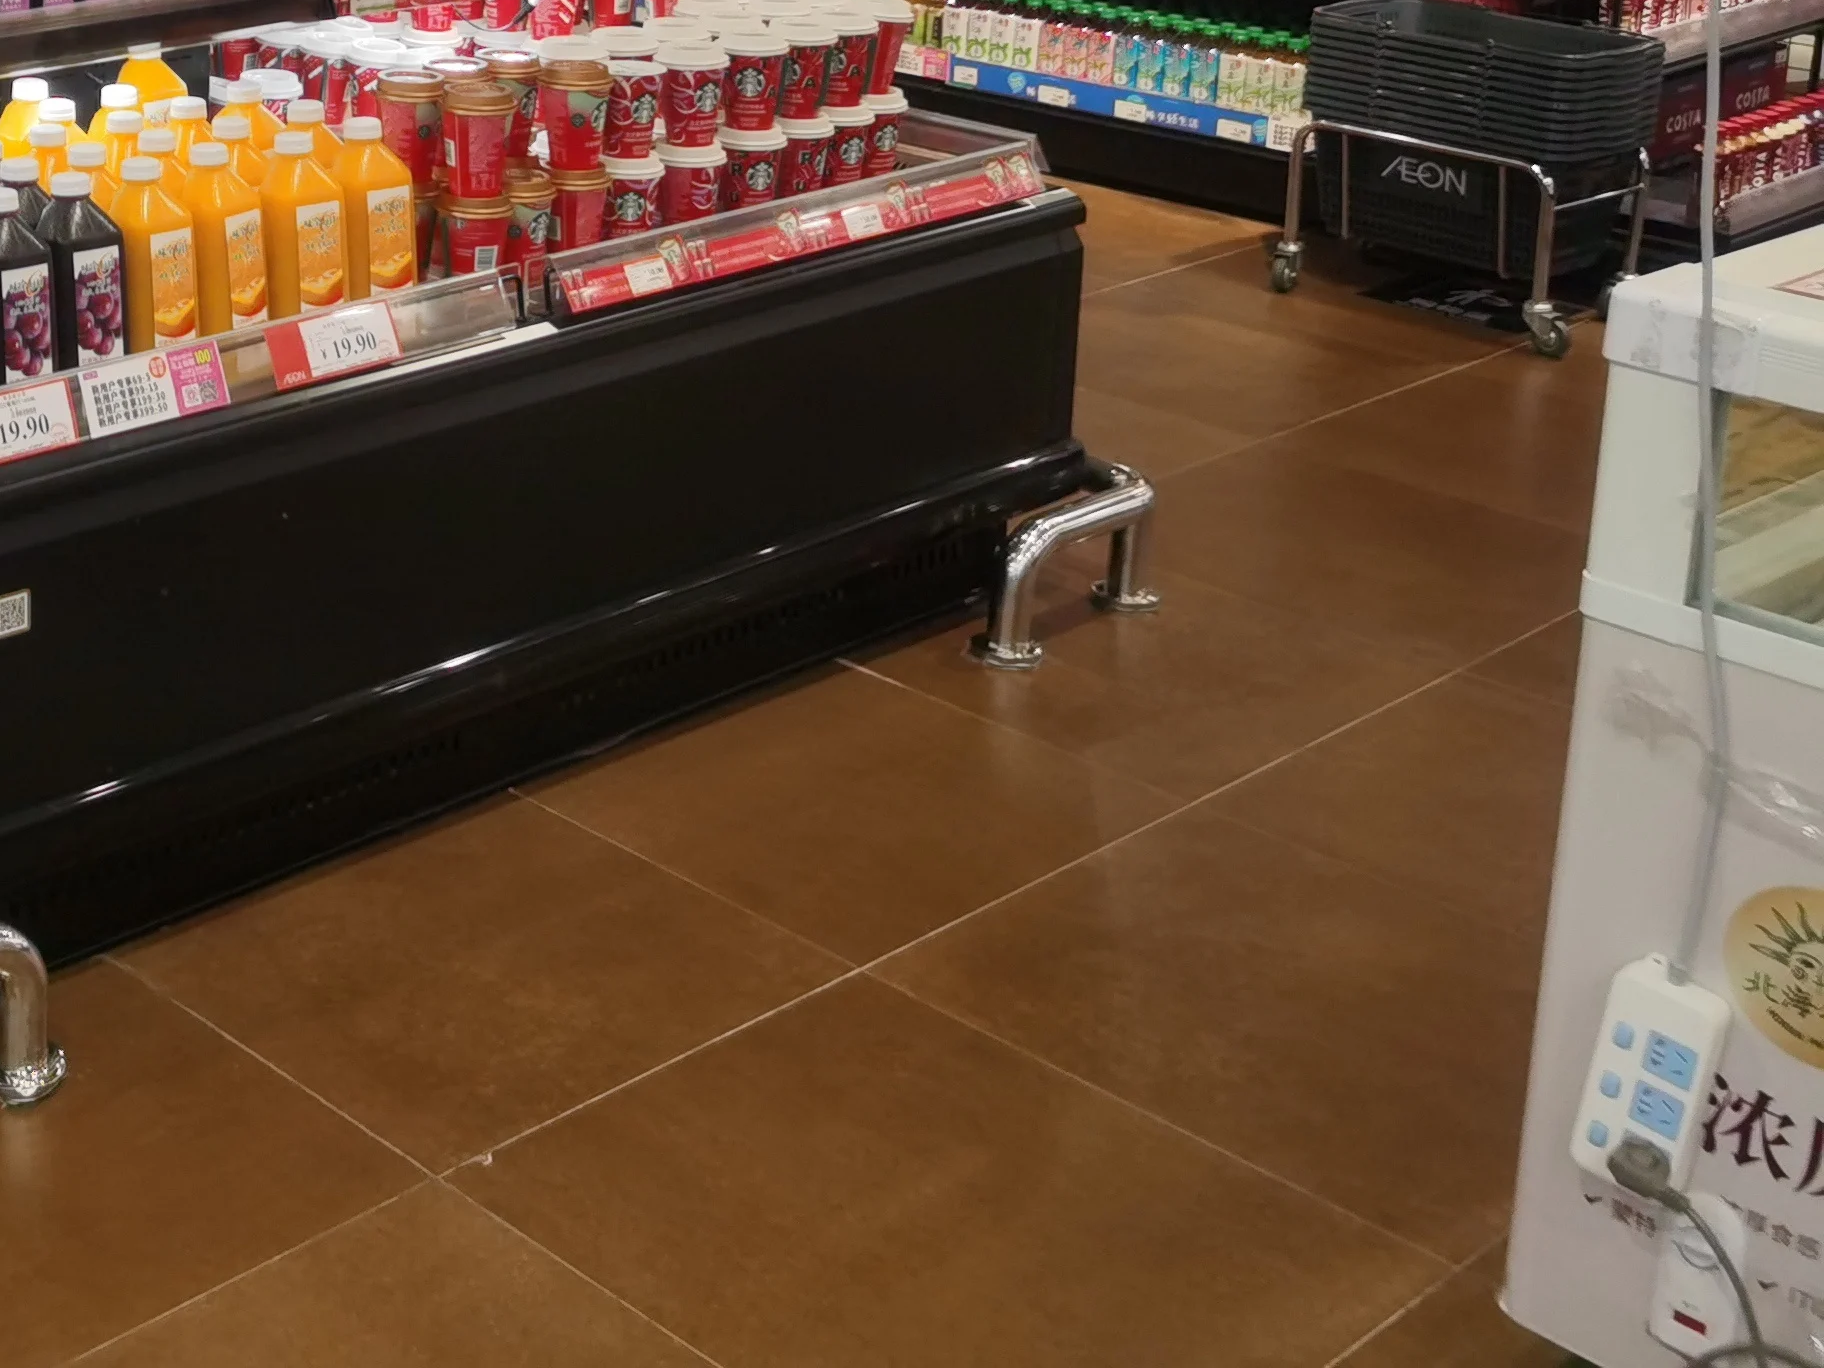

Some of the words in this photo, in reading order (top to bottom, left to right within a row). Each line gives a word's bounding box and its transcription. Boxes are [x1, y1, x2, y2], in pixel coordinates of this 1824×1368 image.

[1736, 85, 1770, 110] COSTA
[1666, 109, 1701, 133] COSTA
[333, 331, 377, 359] 19.90
[0, 413, 50, 444] 19.90
